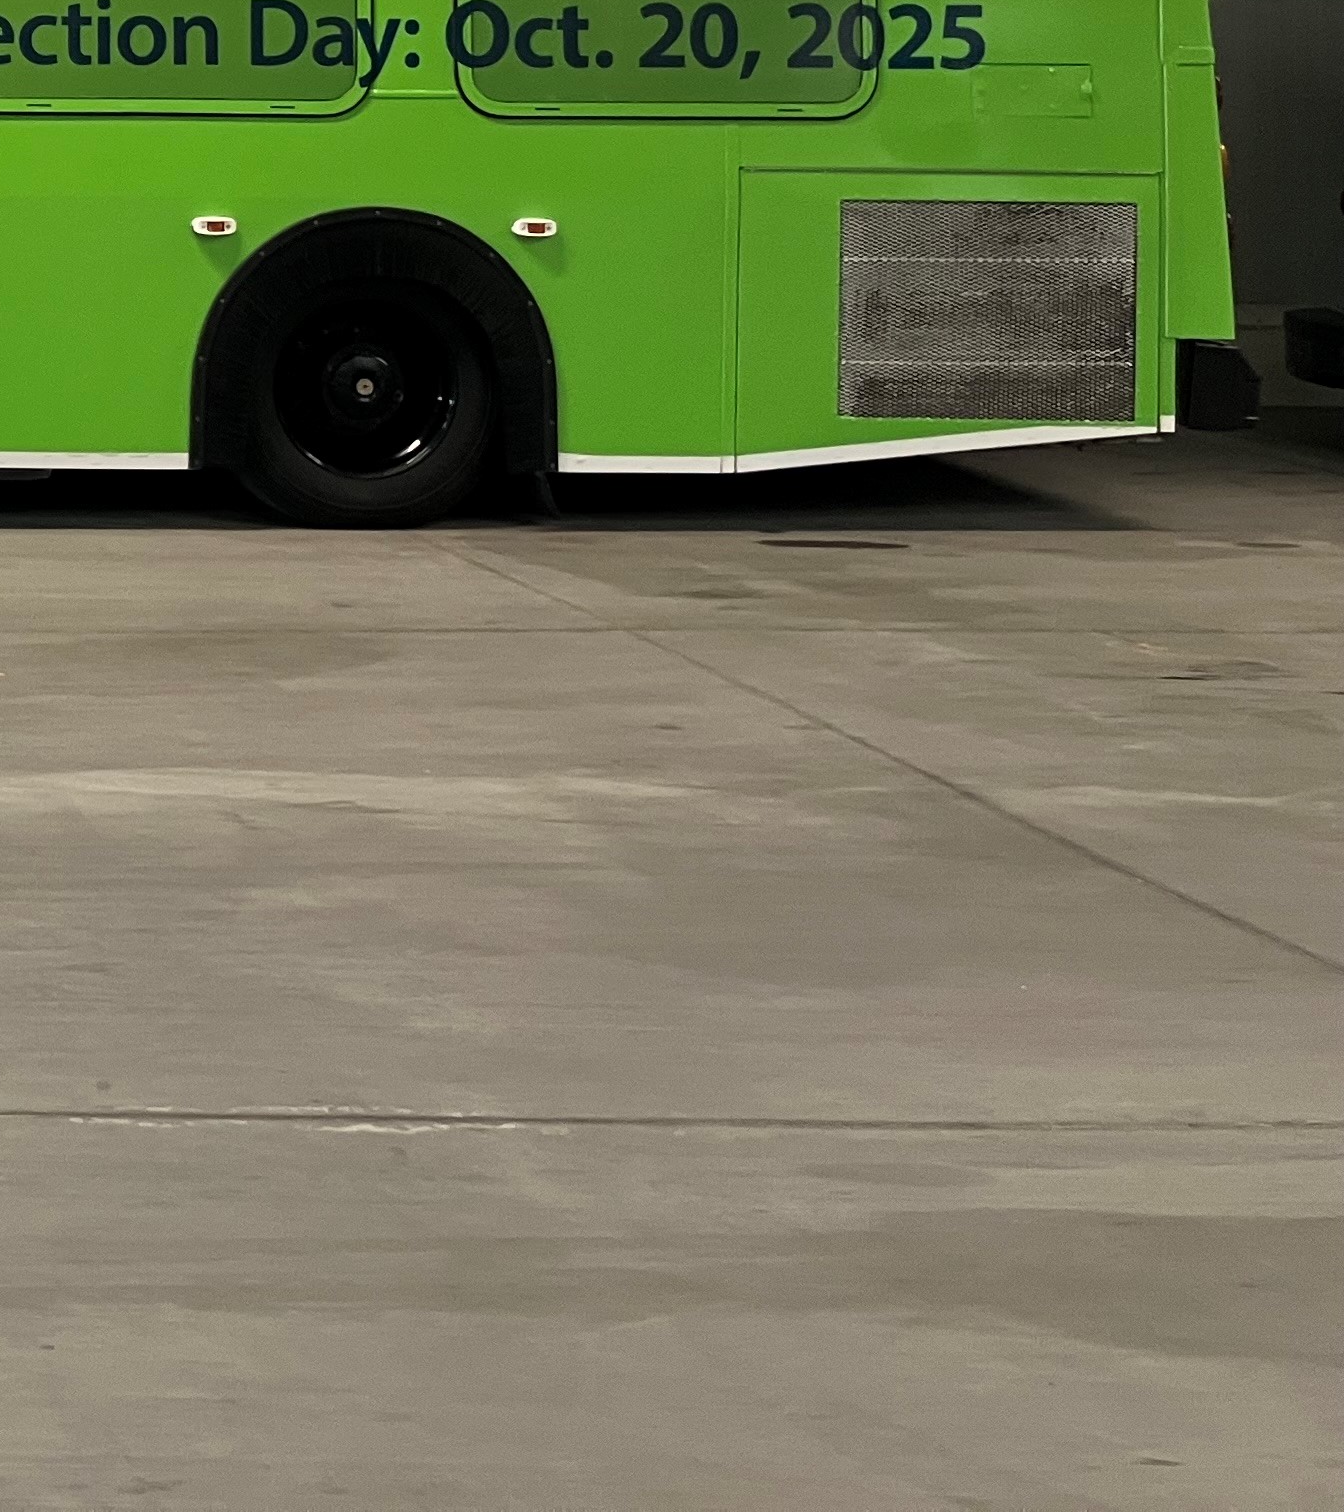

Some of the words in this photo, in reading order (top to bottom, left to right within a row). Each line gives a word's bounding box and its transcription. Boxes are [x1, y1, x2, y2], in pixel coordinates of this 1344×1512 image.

[445, 0, 614, 68] Oct.
[638, 2, 761, 79] 20,
[786, 4, 986, 70] 2025
